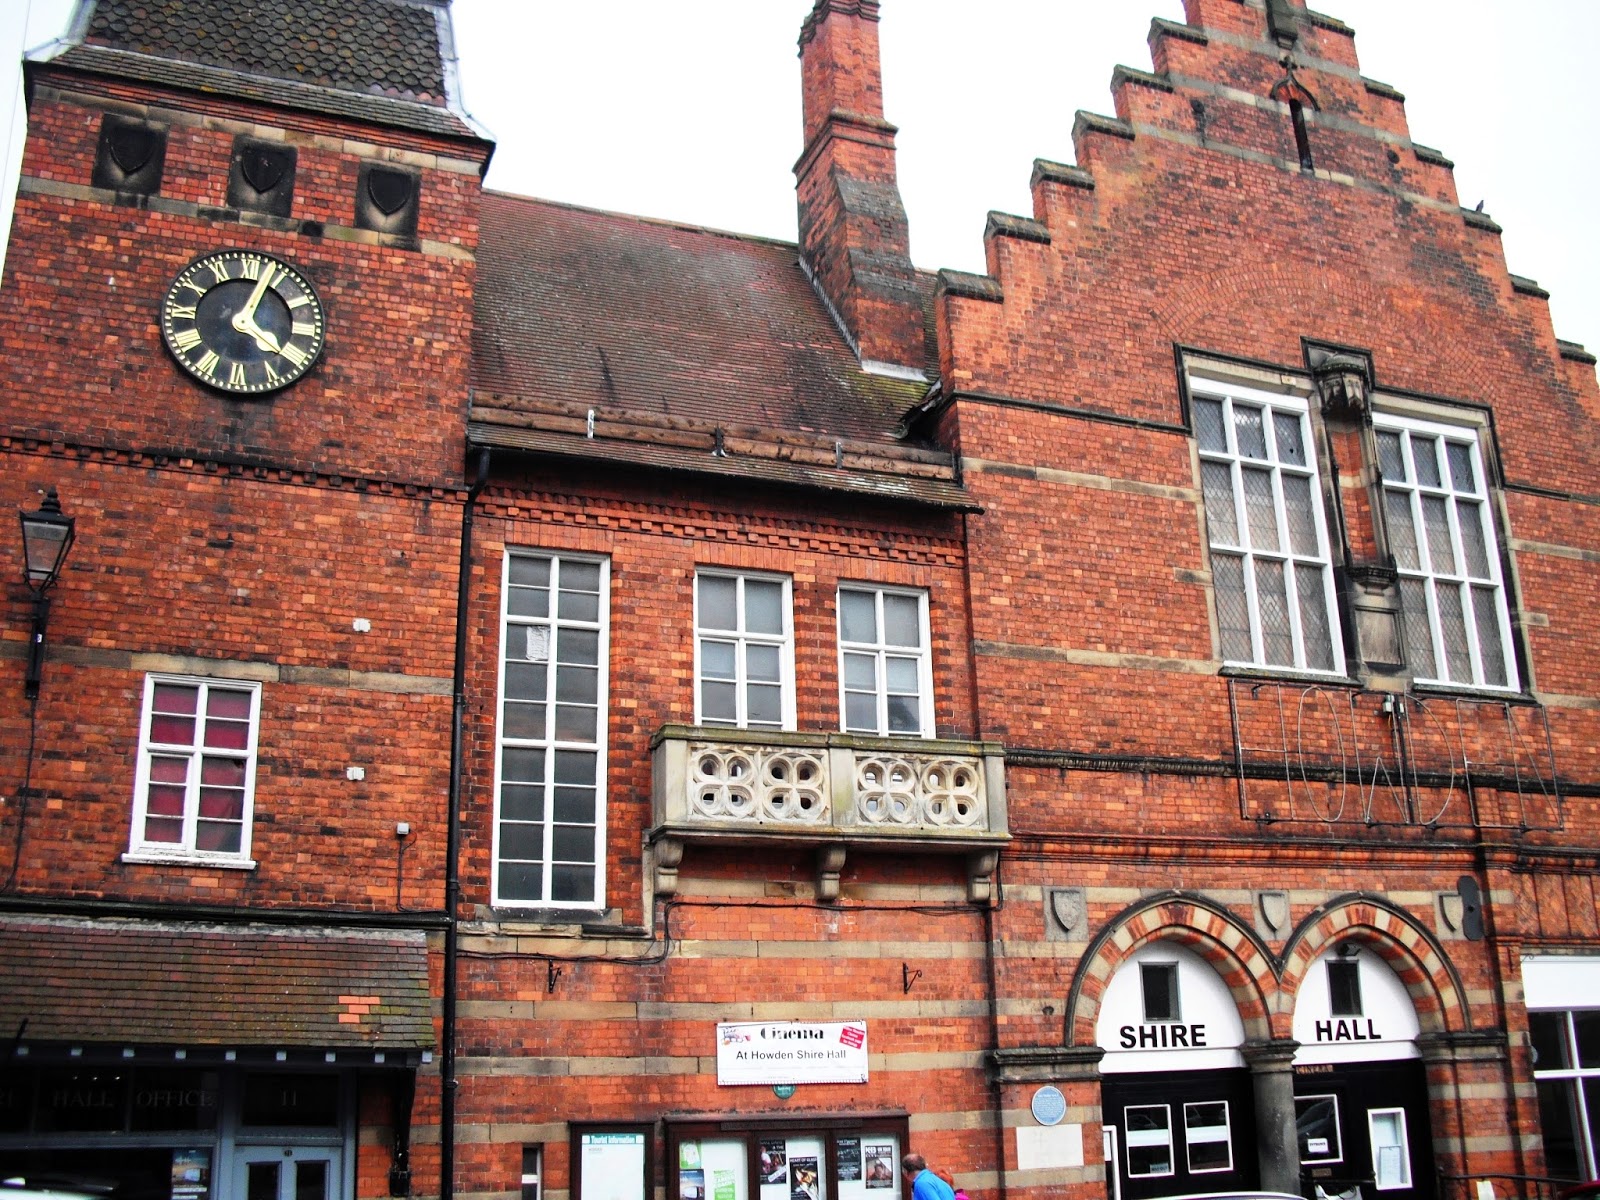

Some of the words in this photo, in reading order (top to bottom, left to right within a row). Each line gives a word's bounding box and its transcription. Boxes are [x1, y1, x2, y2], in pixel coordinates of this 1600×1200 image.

[1119, 1024, 1207, 1049] SHIRE
[1315, 1019, 1381, 1041] HALL
[736, 1050, 747, 1060] At
[751, 1050, 793, 1060] Howden
[797, 1049, 824, 1060] Shire
[827, 1049, 846, 1059] Hall
[53, 1089, 114, 1107] HALL
[136, 1088, 217, 1108] OFFICE
